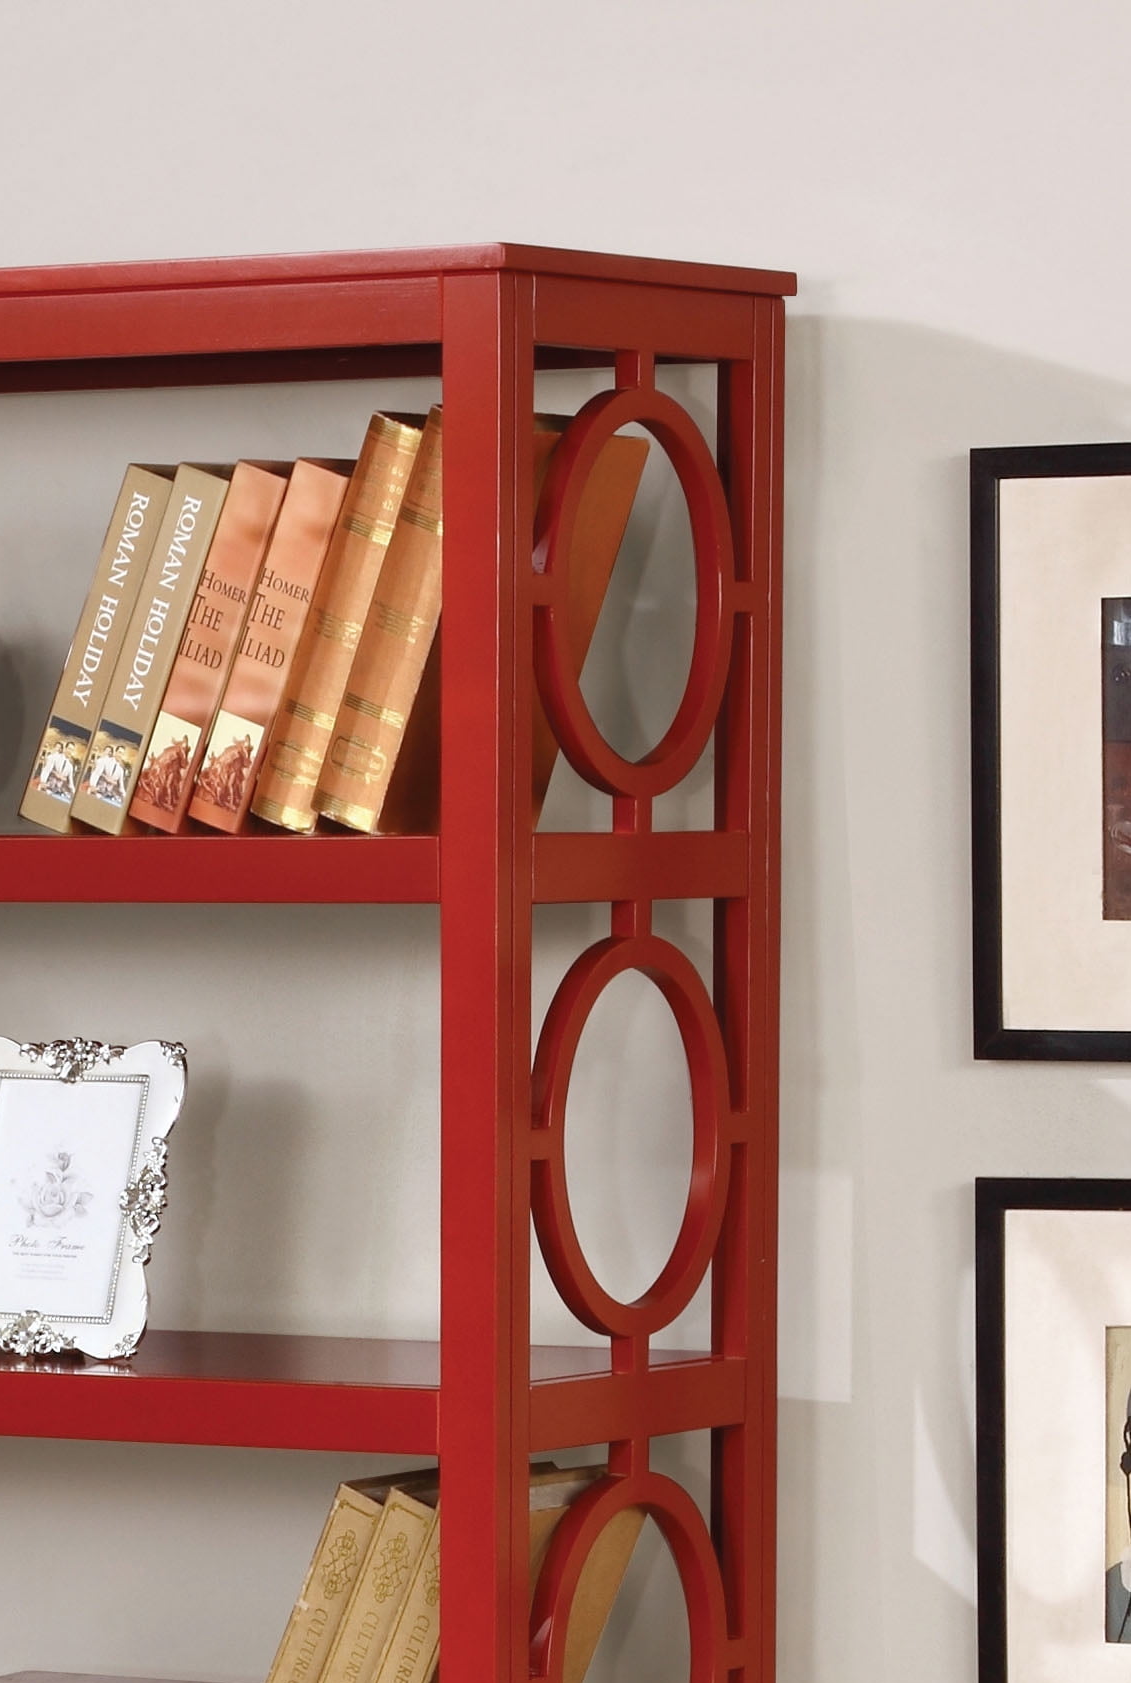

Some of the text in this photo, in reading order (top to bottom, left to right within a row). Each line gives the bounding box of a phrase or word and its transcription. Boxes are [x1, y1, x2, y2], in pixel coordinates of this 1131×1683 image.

[72, 491, 151, 708] ROMAN HOLIDAY
[122, 495, 203, 711] ROMAN HOLIDAY
[200, 569, 247, 605] HOMER
[259, 567, 310, 603] HOMER
[190, 593, 224, 632] THE
[250, 591, 286, 630] THE
[179, 627, 223, 669] ILIAD
[239, 626, 285, 668] ILIAD
[290, 1608, 328, 1678] CULTURE
[346, 1611, 380, 1683] CULTURE
